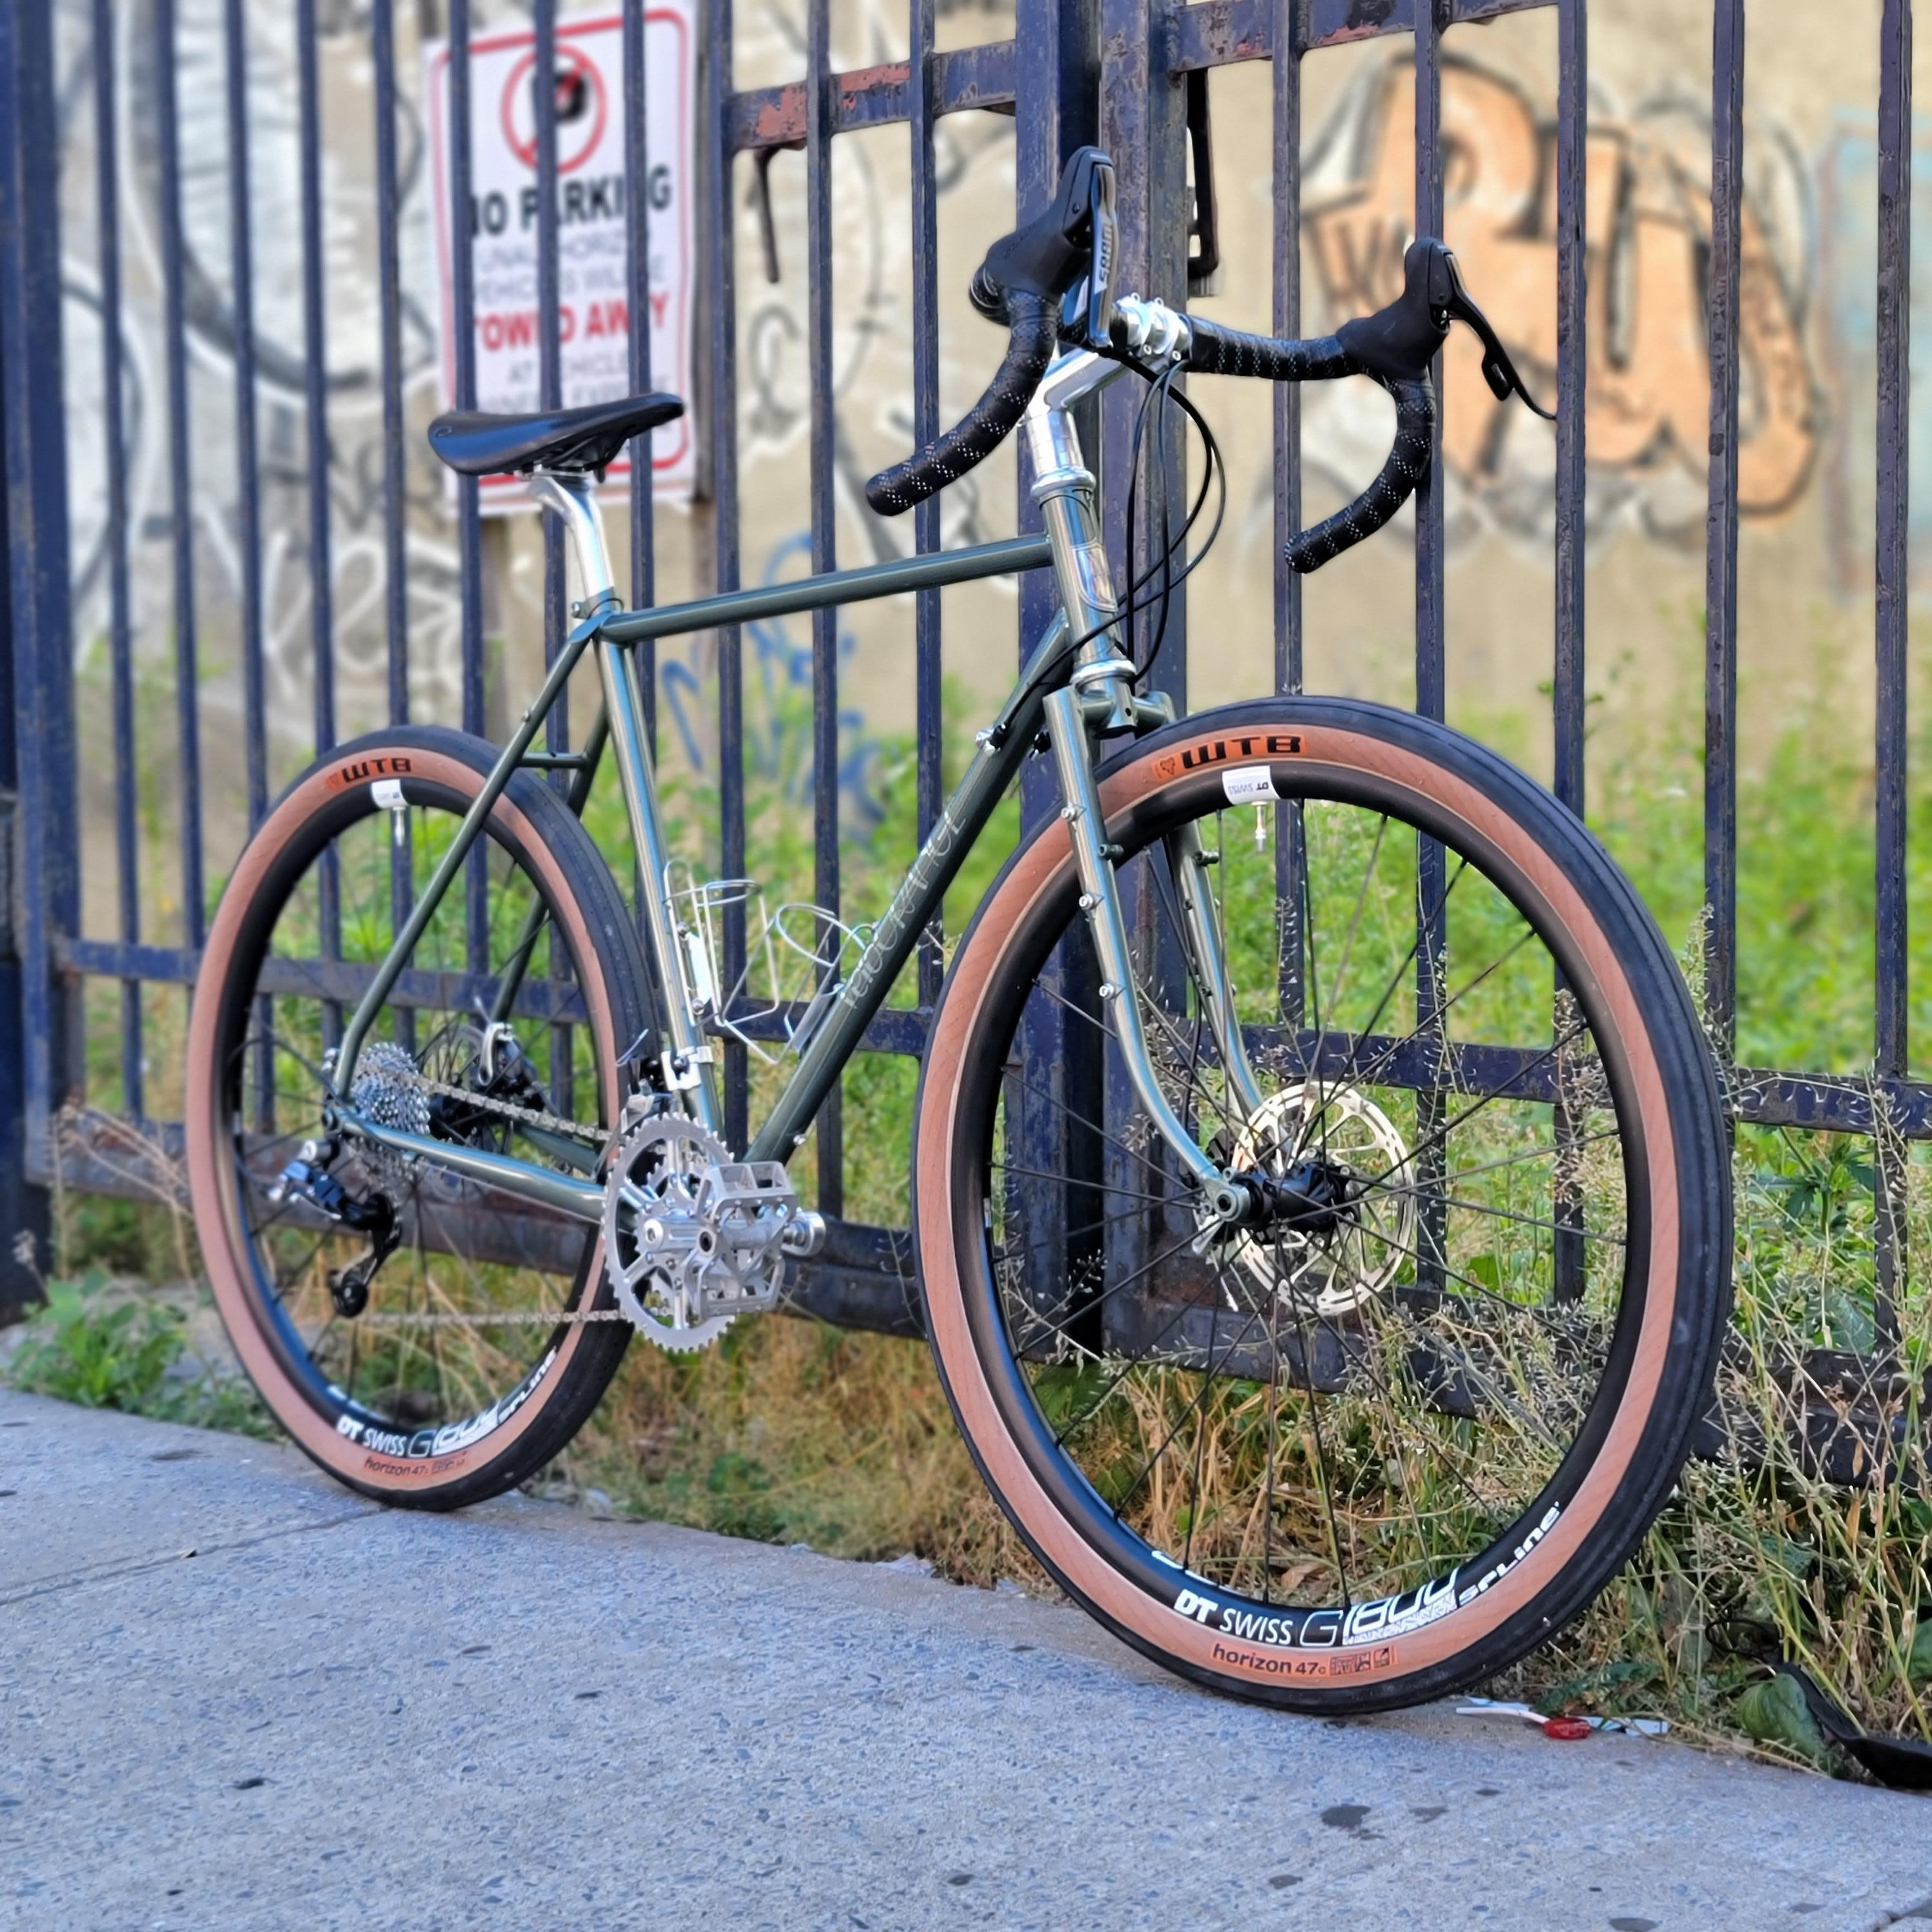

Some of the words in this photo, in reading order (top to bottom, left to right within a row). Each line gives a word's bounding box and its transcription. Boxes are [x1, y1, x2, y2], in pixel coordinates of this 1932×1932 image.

[473, 191, 508, 236] O
[519, 163, 672, 231] PRKIG
[474, 309, 576, 351] OWD
[584, 291, 669, 341] AWY
[342, 757, 411, 783] WTB
[1181, 735, 1301, 769] WTB
[336, 1413, 364, 1441] DT
[362, 1428, 407, 1457] SWISS
[364, 1455, 411, 1476] horizon
[1173, 1588, 1218, 1623] DT
[1218, 1608, 1293, 1645] SWISS
[1213, 1643, 1291, 1674] horizon
